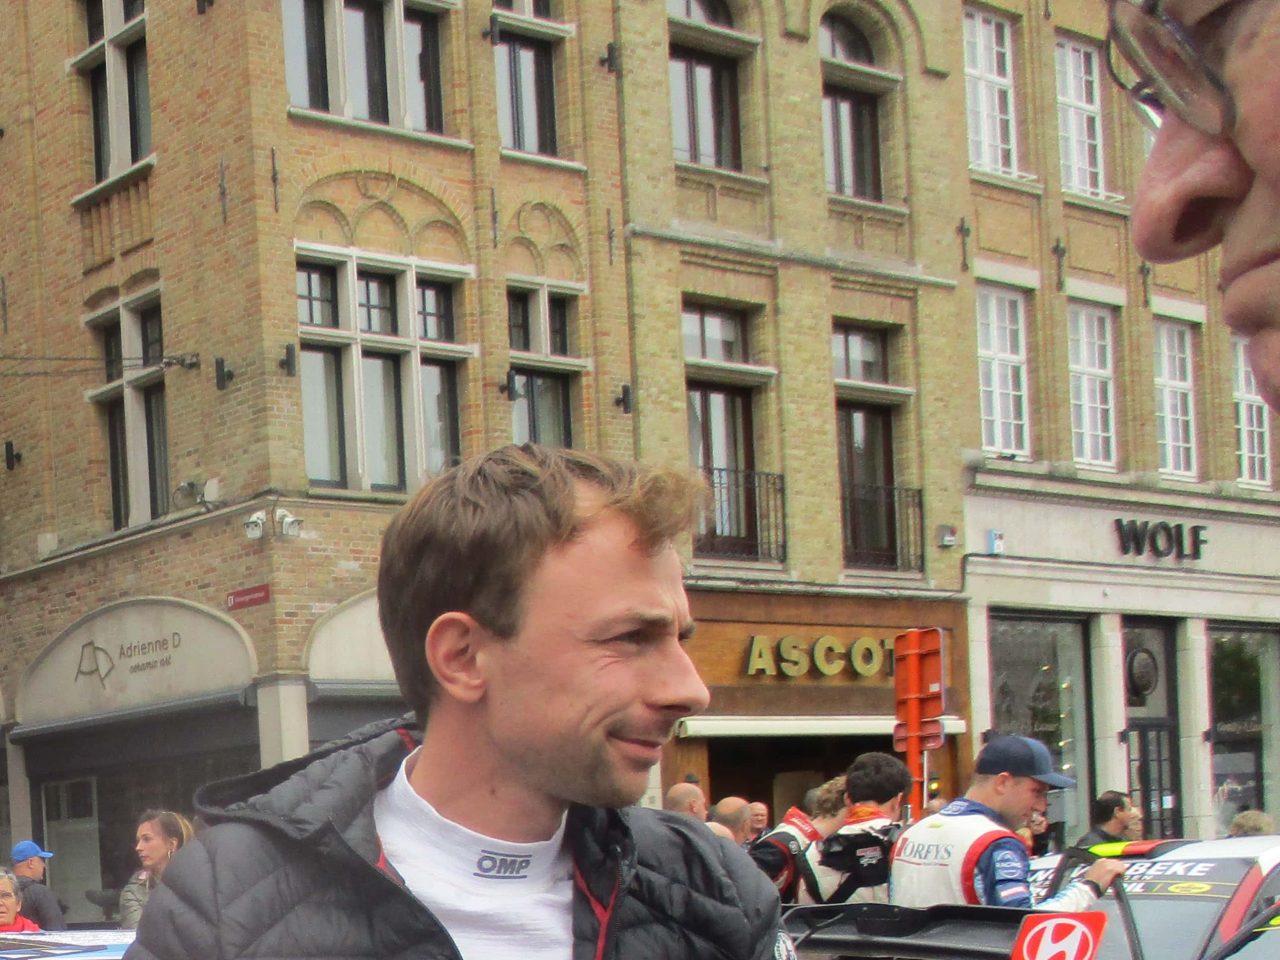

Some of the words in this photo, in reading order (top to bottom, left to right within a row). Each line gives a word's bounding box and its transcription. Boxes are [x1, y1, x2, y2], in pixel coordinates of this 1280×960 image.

[1114, 518, 1208, 560] WOLF
[119, 638, 169, 660] Adrienne
[172, 632, 182, 649] D
[476, 855, 531, 874] OMP
